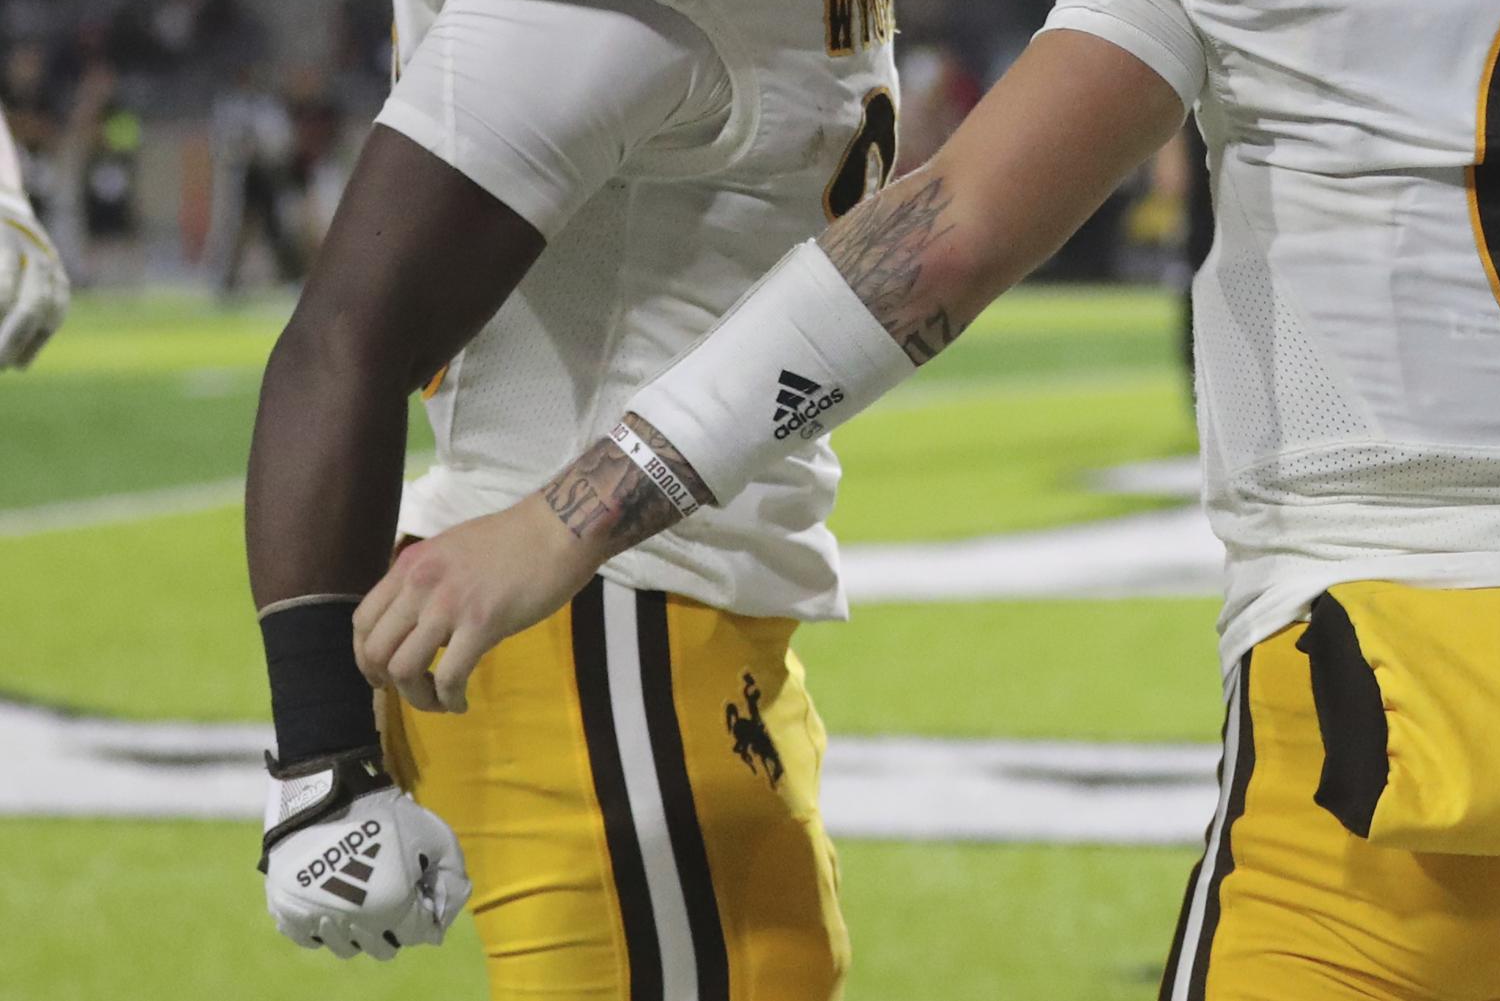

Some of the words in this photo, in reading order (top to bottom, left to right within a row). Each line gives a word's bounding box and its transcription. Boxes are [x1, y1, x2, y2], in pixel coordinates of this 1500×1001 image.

[774, 388, 844, 440] adidas
[644, 457, 688, 506] TOUGH
[296, 819, 382, 888] adidas
